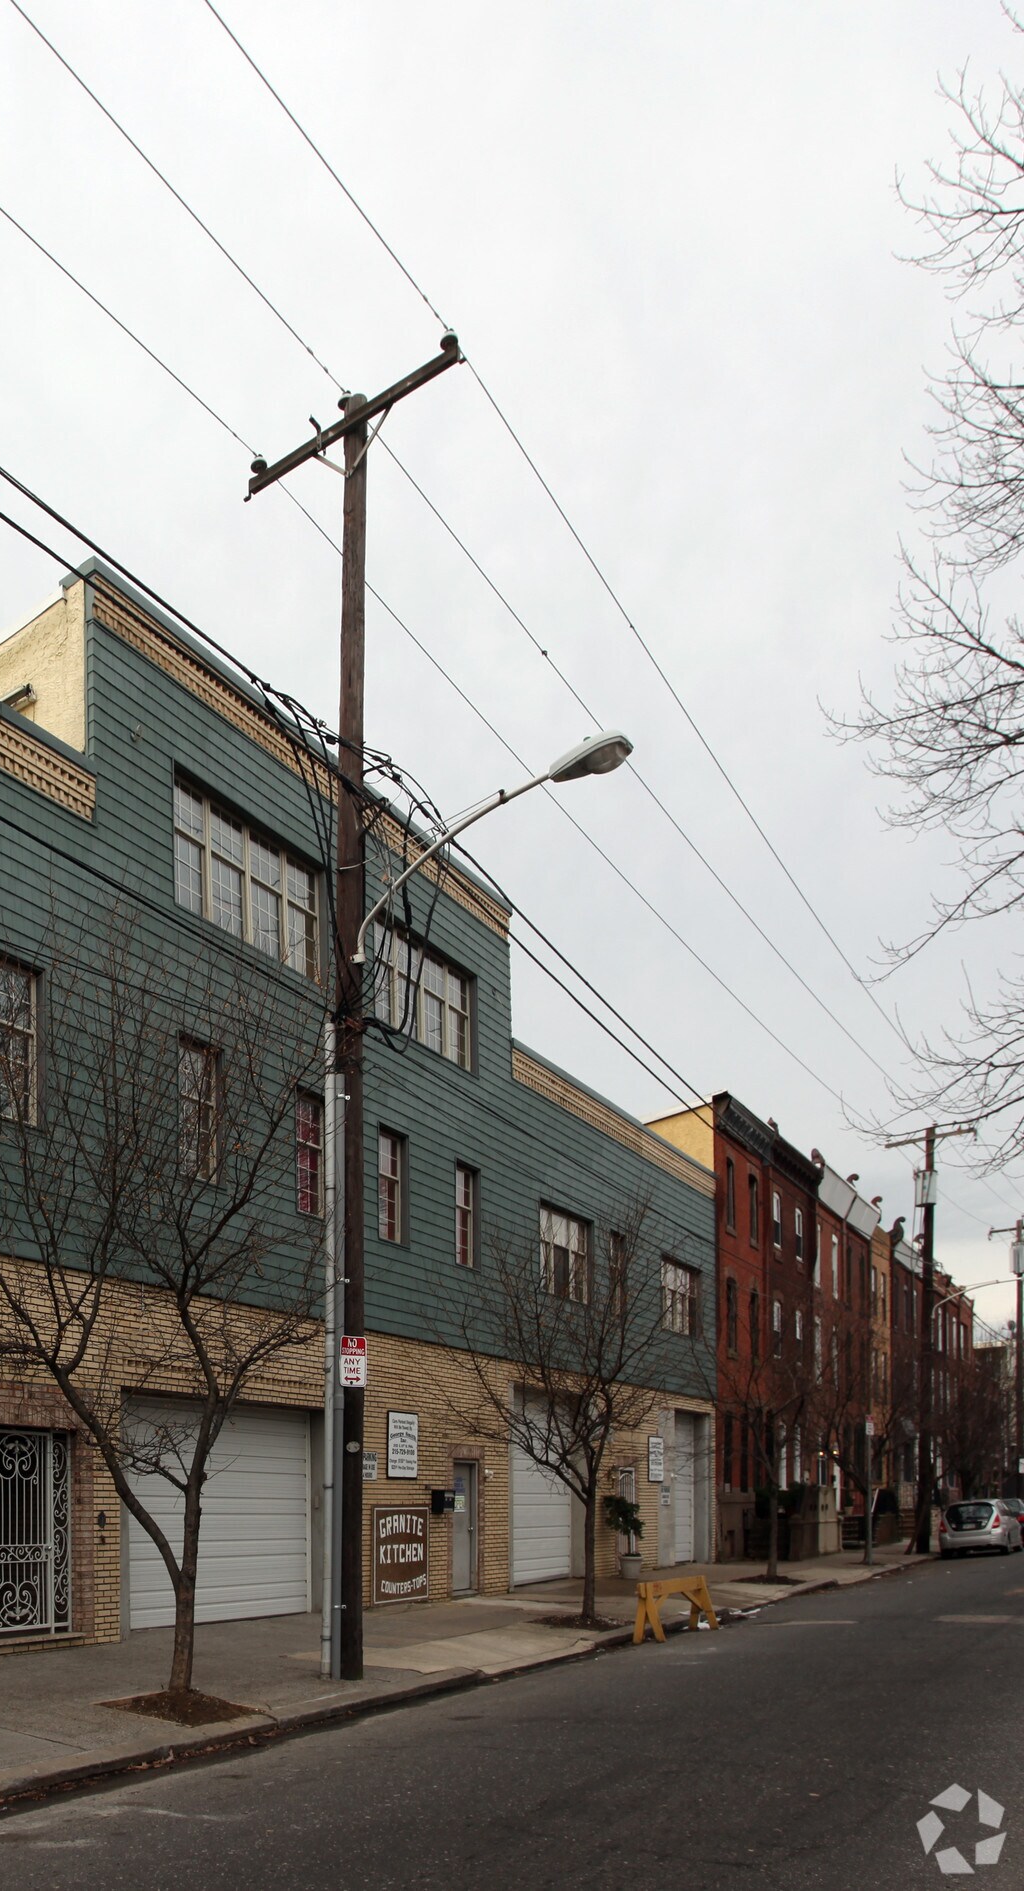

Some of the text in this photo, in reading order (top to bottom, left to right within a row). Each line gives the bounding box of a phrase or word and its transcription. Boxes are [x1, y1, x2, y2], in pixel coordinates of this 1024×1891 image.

[347, 1338, 358, 1348] NO
[341, 1347, 365, 1355] STOPPING
[344, 1367, 361, 1375] TIME
[379, 1514, 424, 1539] GRANITE
[379, 1543, 424, 1564] KITCHEN
[380, 1573, 427, 1594] COUNTERS-TOPS
